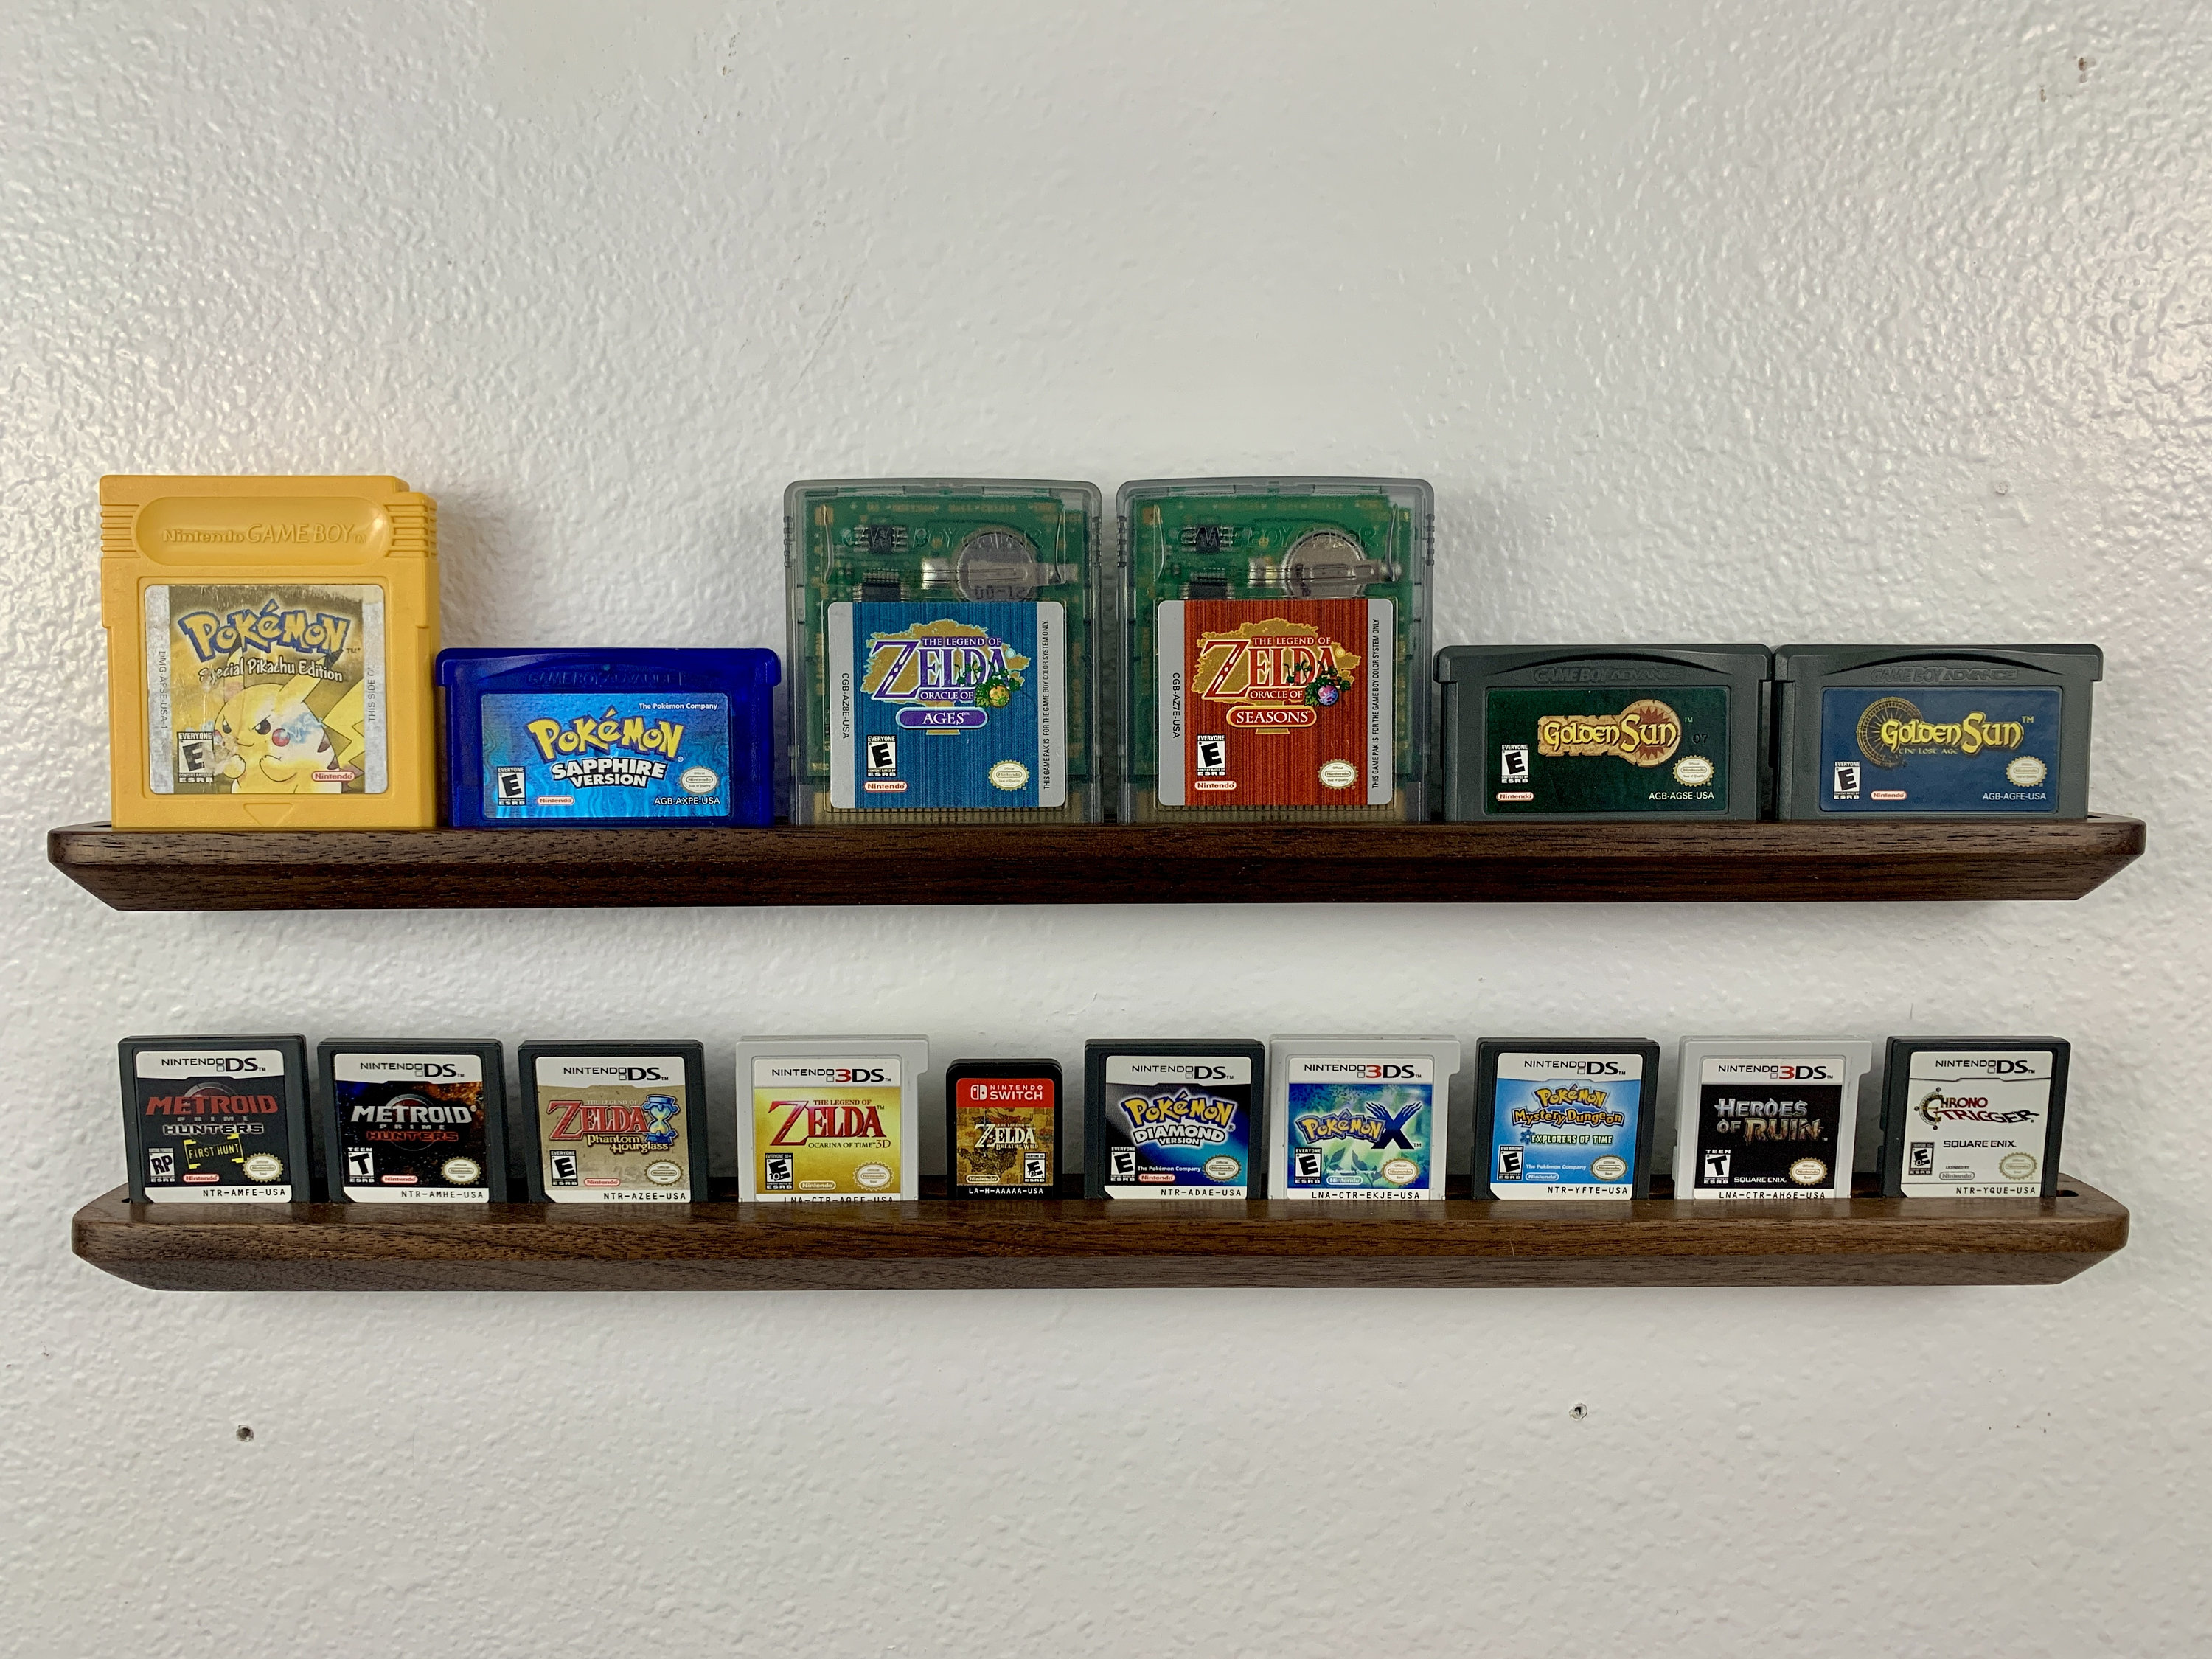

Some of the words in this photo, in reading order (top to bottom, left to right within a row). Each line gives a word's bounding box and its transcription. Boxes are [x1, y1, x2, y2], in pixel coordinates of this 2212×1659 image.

[162, 529, 244, 543] Nintendo
[246, 523, 310, 543] GAME
[313, 524, 354, 543] BOY
[922, 637, 943, 645] THE
[946, 637, 985, 645] LEGEND
[988, 637, 1001, 645] OF
[247, 655, 295, 675] Pikachu
[298, 660, 344, 682] Edition
[872, 640, 1011, 699] ZELDA
[1201, 640, 1338, 699] ZELDA
[920, 691, 958, 700] ORACLE
[960, 691, 973, 700] OF
[1249, 689, 1287, 699] ORACLE
[1290, 689, 1303, 699] OF
[686, 703, 718, 711] Company
[841, 672, 850, 739] CGB-AZ8E-USA
[1172, 672, 1180, 738] CGB-AZ7E-USA
[922, 713, 964, 724] AGES
[1236, 711, 1309, 723] SEASONS
[1543, 722, 1620, 751] Golden
[1620, 714, 1678, 753] Sun
[1880, 719, 1962, 752] Golden
[1962, 711, 2024, 754] Sun
[550, 757, 668, 779] SAPPHIRE
[571, 773, 647, 787] VERSION
[1648, 791, 1714, 800] AGB-AGSE-USA
[1983, 792, 2047, 801] AGB-AGFE-USA
[161, 1058, 224, 1066] NINTENDO
[225, 1057, 258, 1072] DS
[423, 1063, 456, 1077] DS
[1587, 1061, 1618, 1075] DS
[1996, 1060, 2028, 1074] DS
[627, 1067, 661, 1081] DS
[835, 1068, 885, 1083] 3DS
[1194, 1065, 1226, 1079] DS
[1366, 1065, 1415, 1079] 3DS
[1778, 1065, 1827, 1079] 3DS
[990, 1091, 1043, 1100] SWITCH
[145, 1095, 279, 1116] METROID
[1714, 1098, 1808, 1118] HEROES
[350, 1106, 473, 1124] METROID
[546, 1099, 651, 1140] ZELDA
[1514, 1109, 1567, 1127] Mystery
[1566, 1109, 1624, 1127] Dungeon
[1935, 1109, 2039, 1124] TRIGGER
[163, 1124, 264, 1135] HUNTERS
[768, 1100, 887, 1146] ZELDA
[1365, 1102, 1422, 1150] X
[366, 1131, 459, 1141] HUNTERS
[974, 1124, 1037, 1148] ZELDA
[1133, 1124, 1225, 1144] DIAMOND
[1717, 1119, 1741, 1134] OF
[1743, 1117, 1823, 1144] RUIN
[587, 1134, 640, 1147] Phantom
[875, 1139, 891, 1149] 3D
[1158, 1137, 1201, 1147] VERSION
[1531, 1135, 1577, 1144] EXPLORERS
[1579, 1135, 1589, 1144] OF
[1593, 1135, 1613, 1144] TIME
[1943, 1140, 1989, 1148] SQUARE
[188, 1147, 214, 1160] FIRST
[217, 1144, 240, 1155] HUNT
[611, 1142, 669, 1153] Hourglass
[202, 1188, 285, 1197] NTR-AMFE-USA
[401, 1190, 484, 1198] NTR-AMHE-USA
[603, 1192, 686, 1200] NTR-AZEE-USA
[1161, 1189, 1242, 1197] NTR-ADAE-USA
[1312, 1192, 1420, 1200] LNA-CTR-EKJE-USA
[1955, 1186, 2036, 1194] NTR-YQUE-USA
